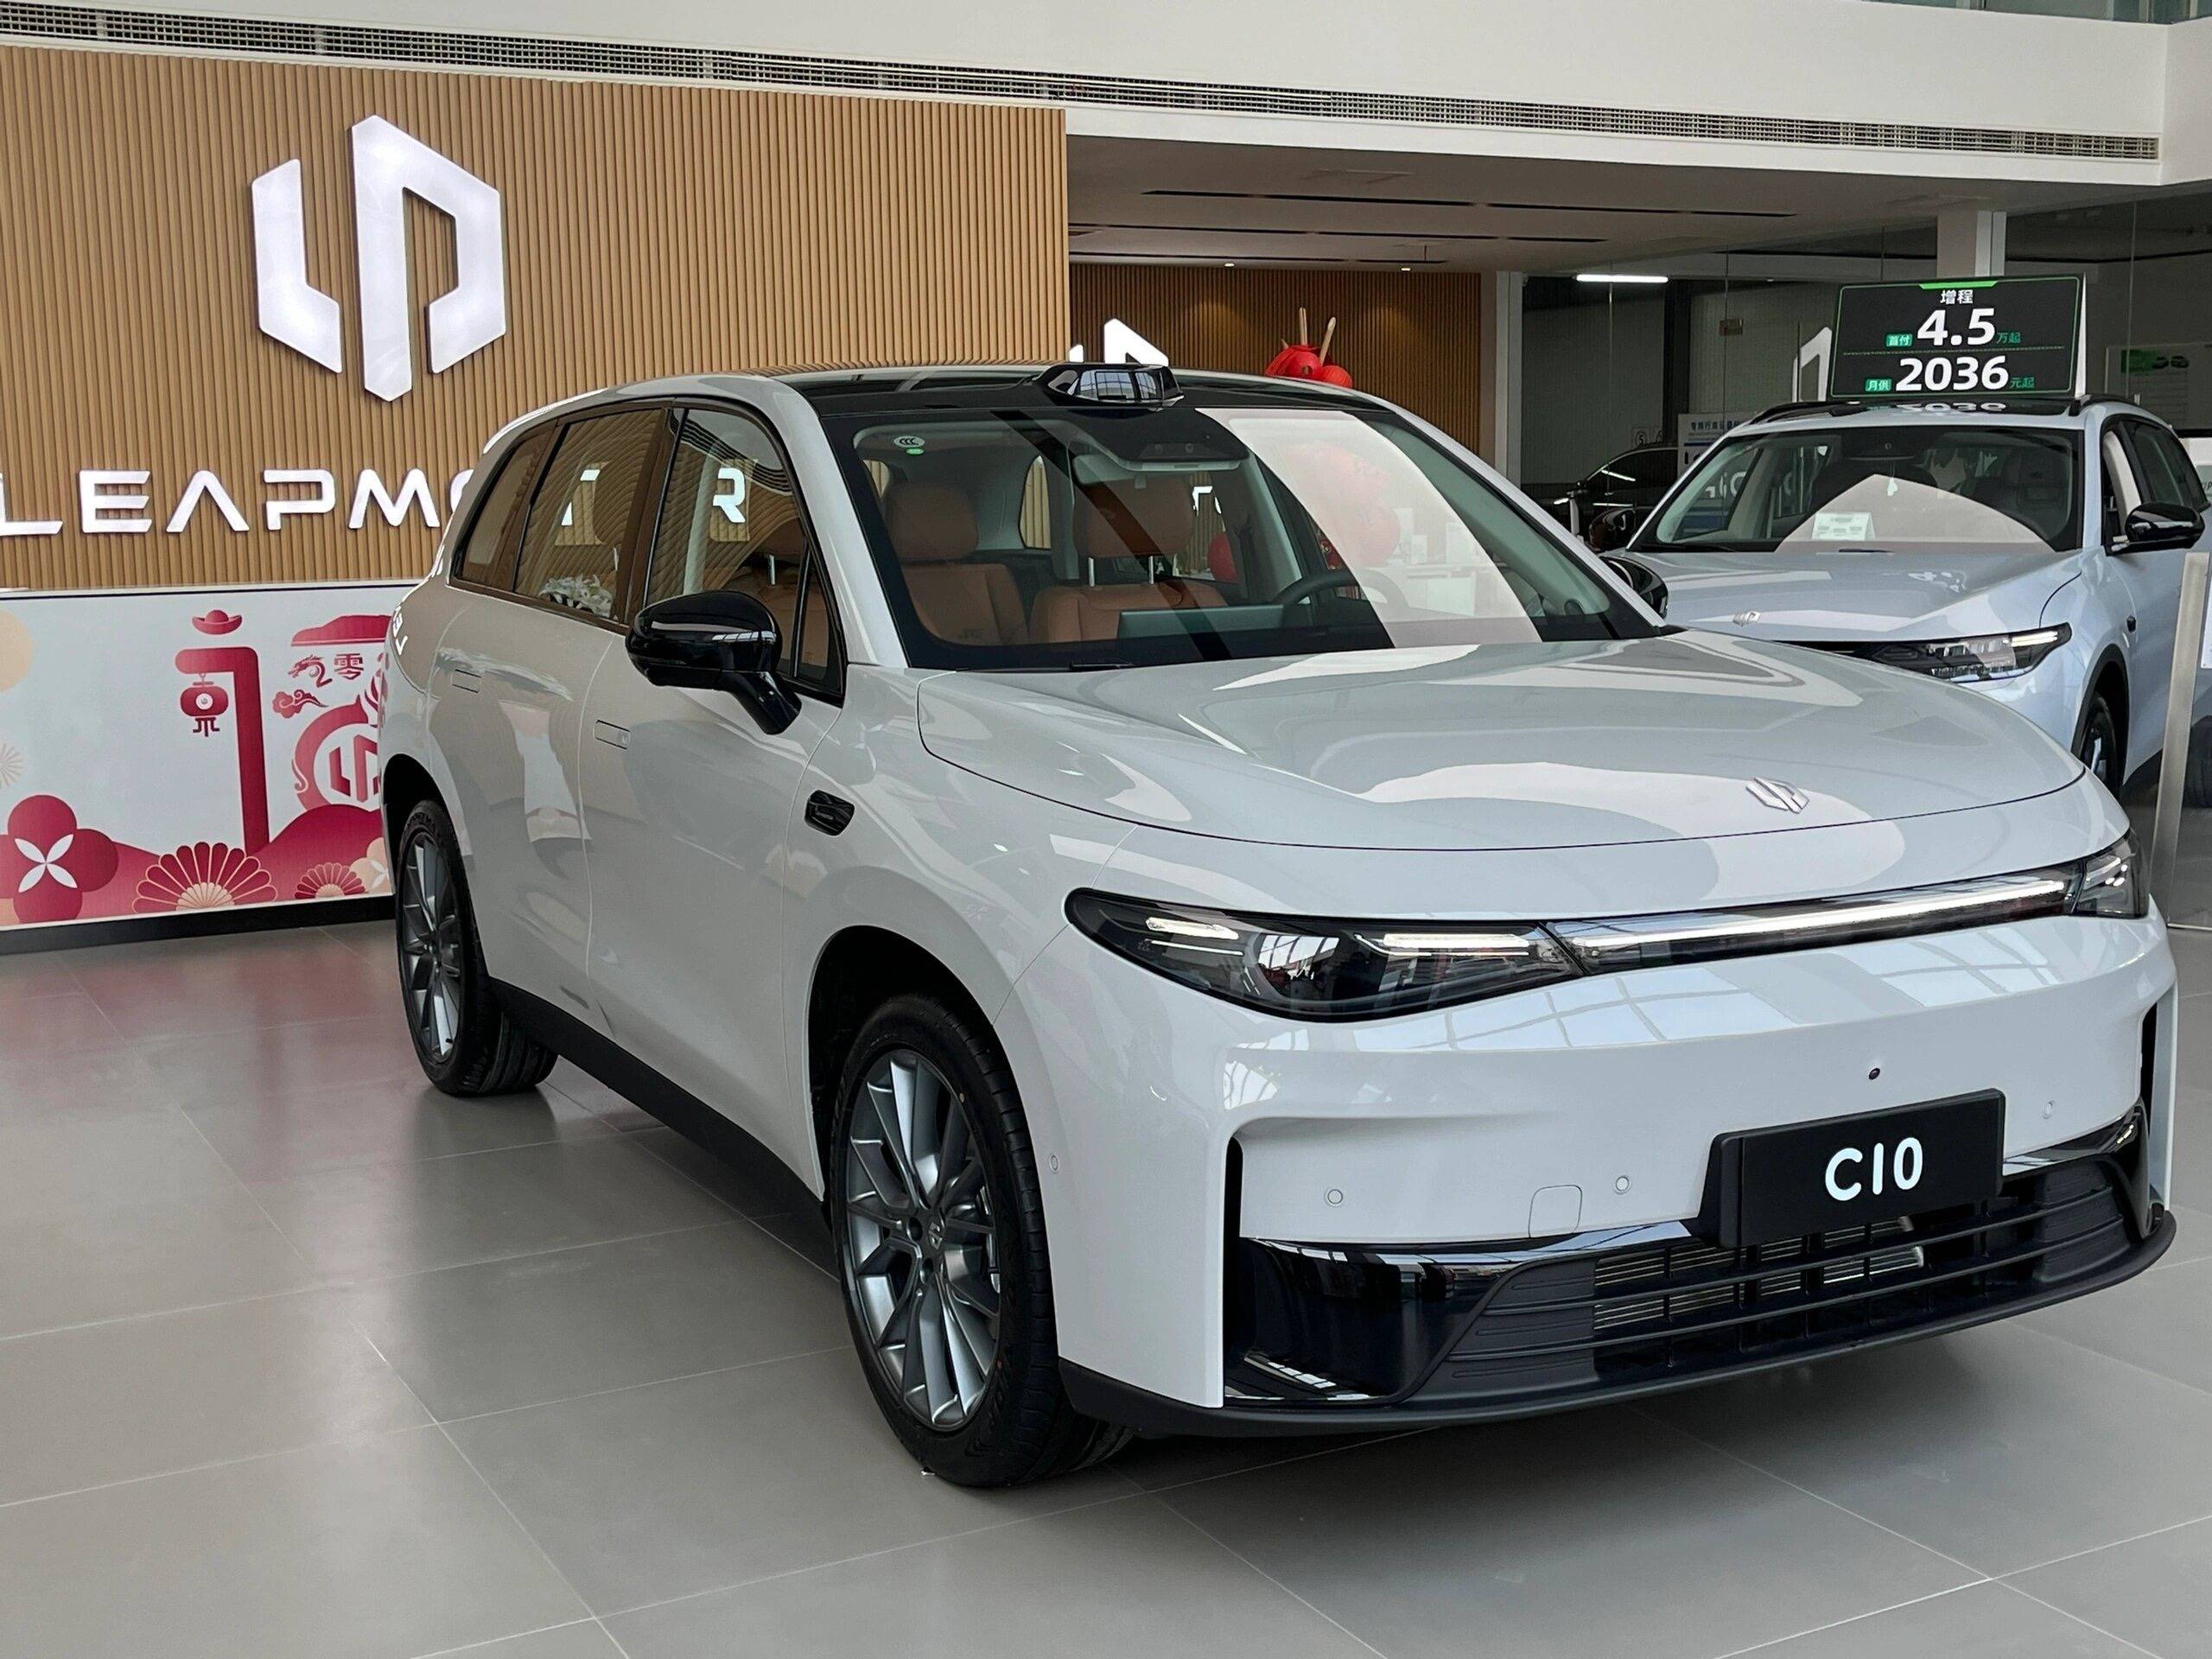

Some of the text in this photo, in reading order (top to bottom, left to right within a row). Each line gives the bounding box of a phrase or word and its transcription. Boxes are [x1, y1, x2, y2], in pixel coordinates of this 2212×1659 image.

[1940, 289, 1974, 304] 增程
[1888, 308, 2022, 346] 首付 4.5 万起
[1867, 355, 2035, 391] 月供 2036 元起
[1825, 1137, 1923, 1202] C10
